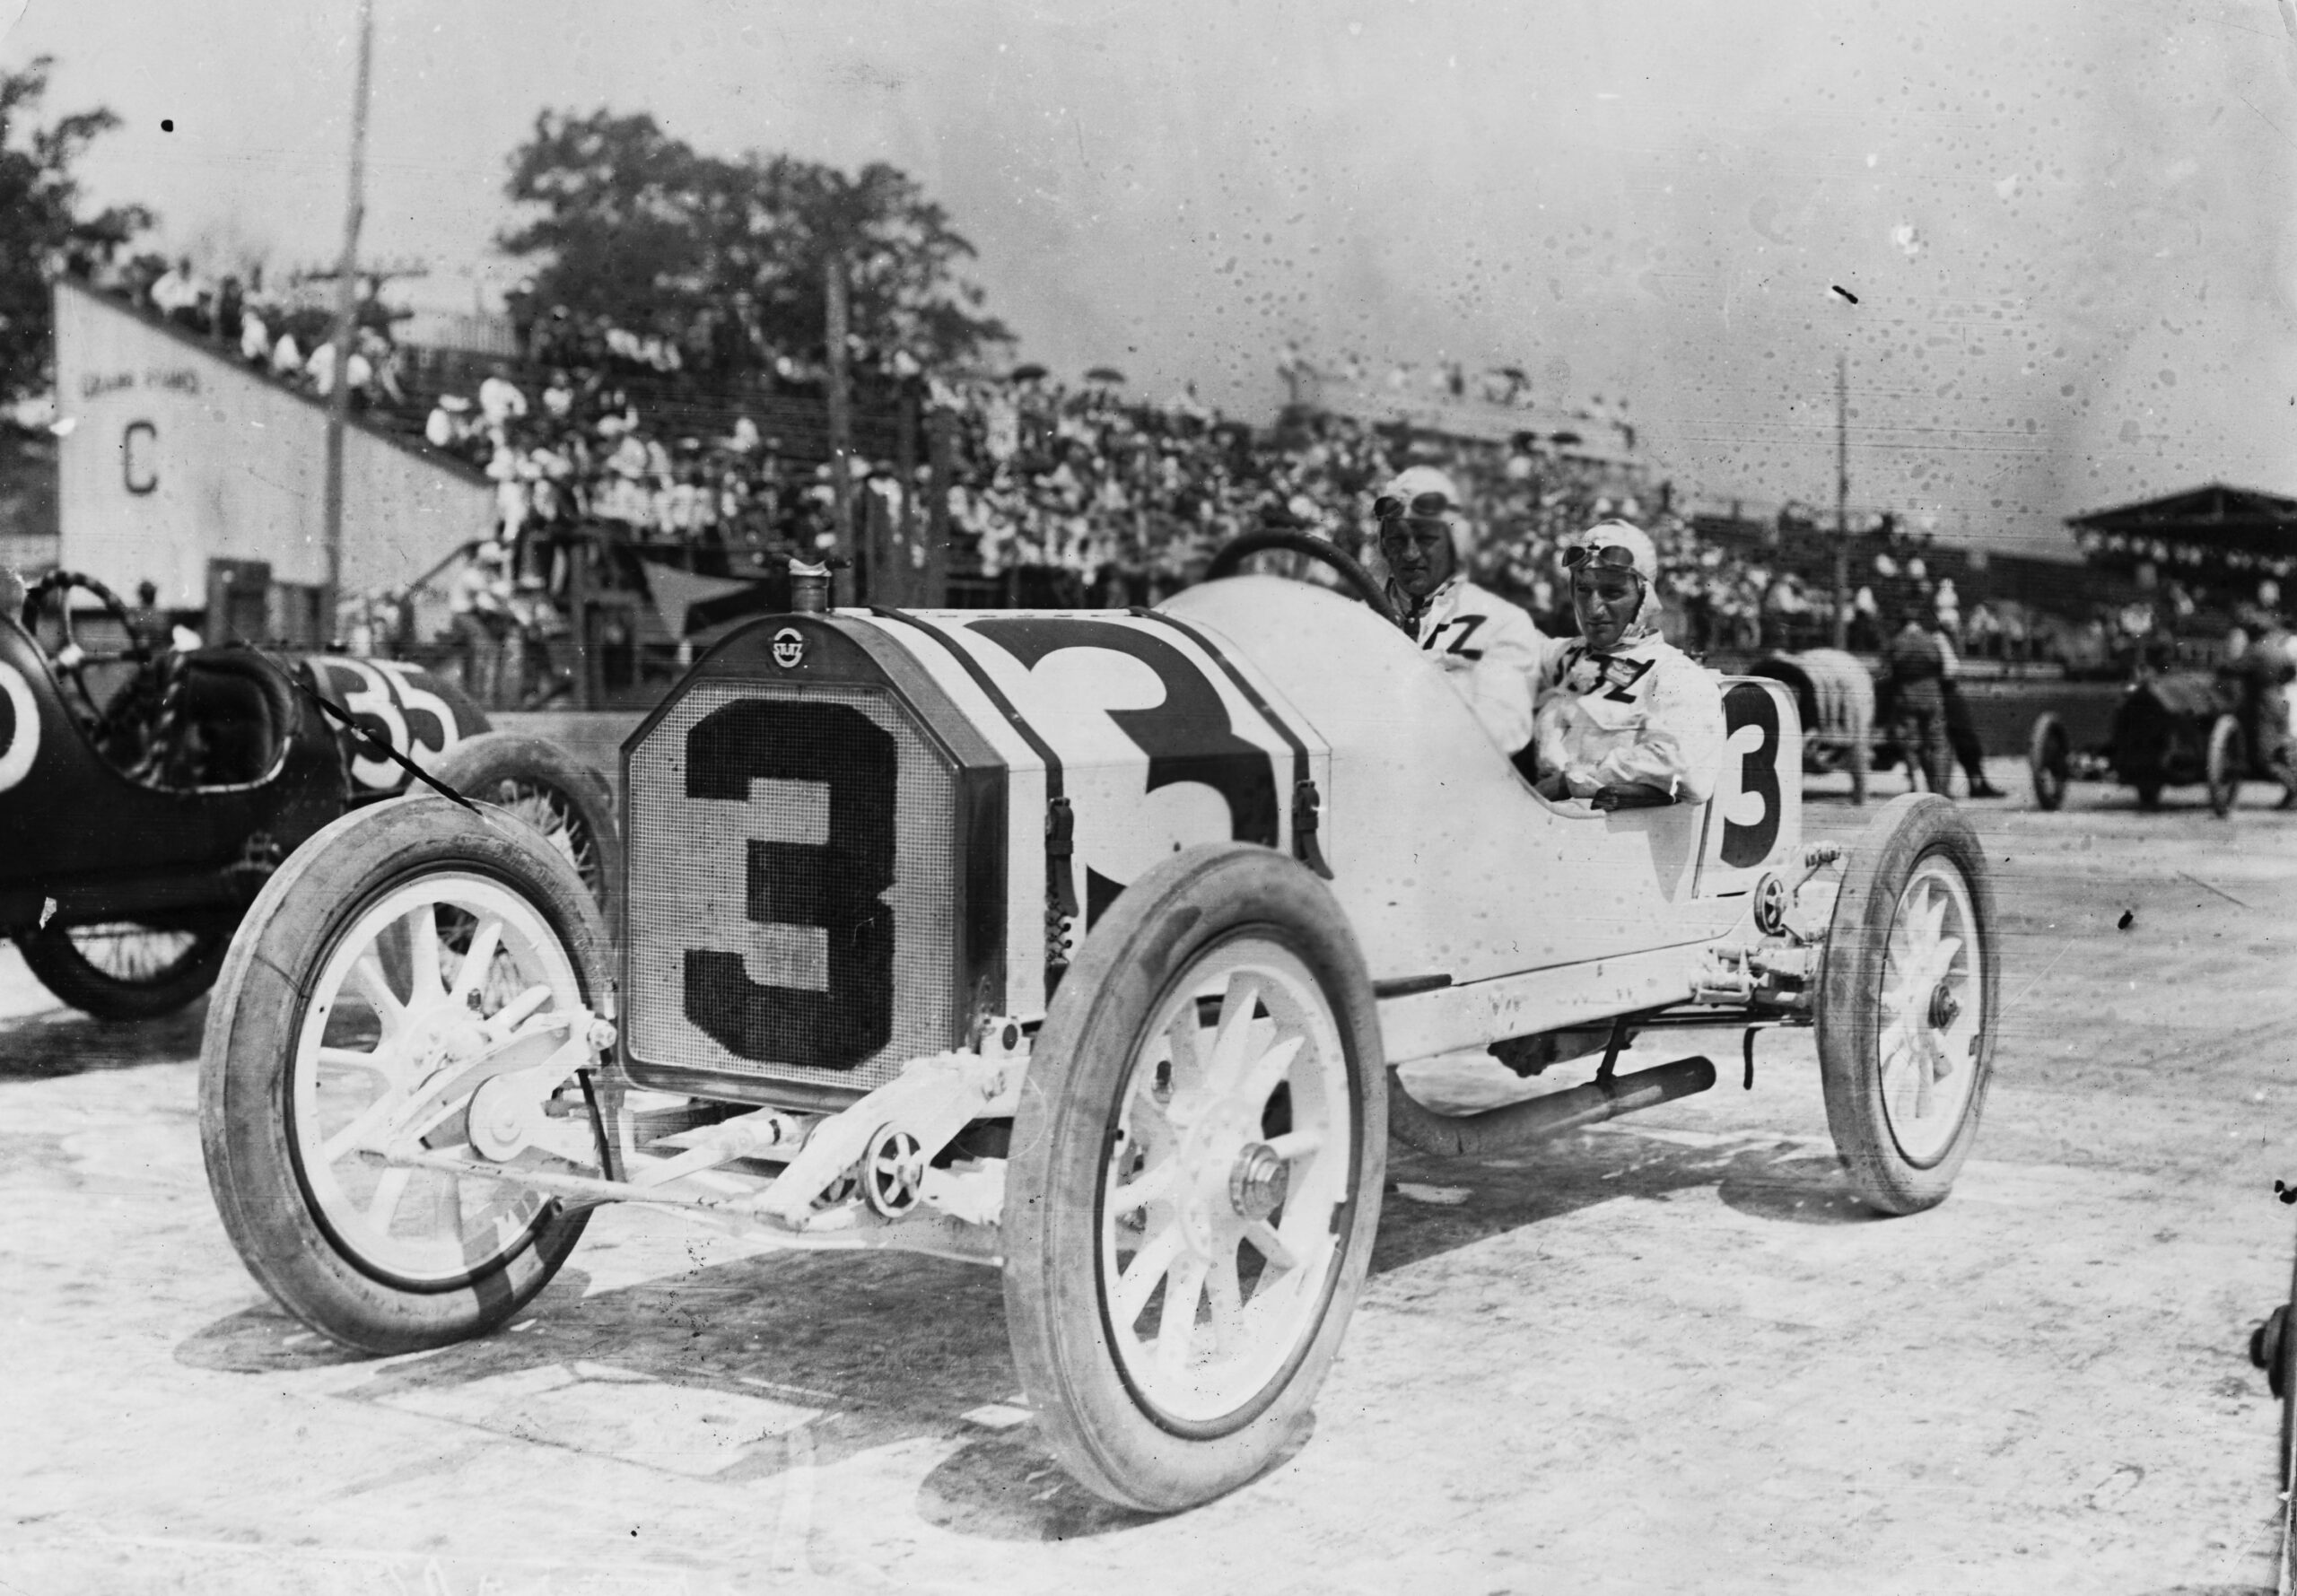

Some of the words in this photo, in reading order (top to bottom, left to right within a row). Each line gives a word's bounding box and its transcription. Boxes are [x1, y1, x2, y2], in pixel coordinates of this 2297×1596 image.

[123, 419, 157, 496] C
[773, 642, 803, 656] STUTZ
[1721, 682, 1781, 868] 3
[684, 699, 895, 1071] 3
